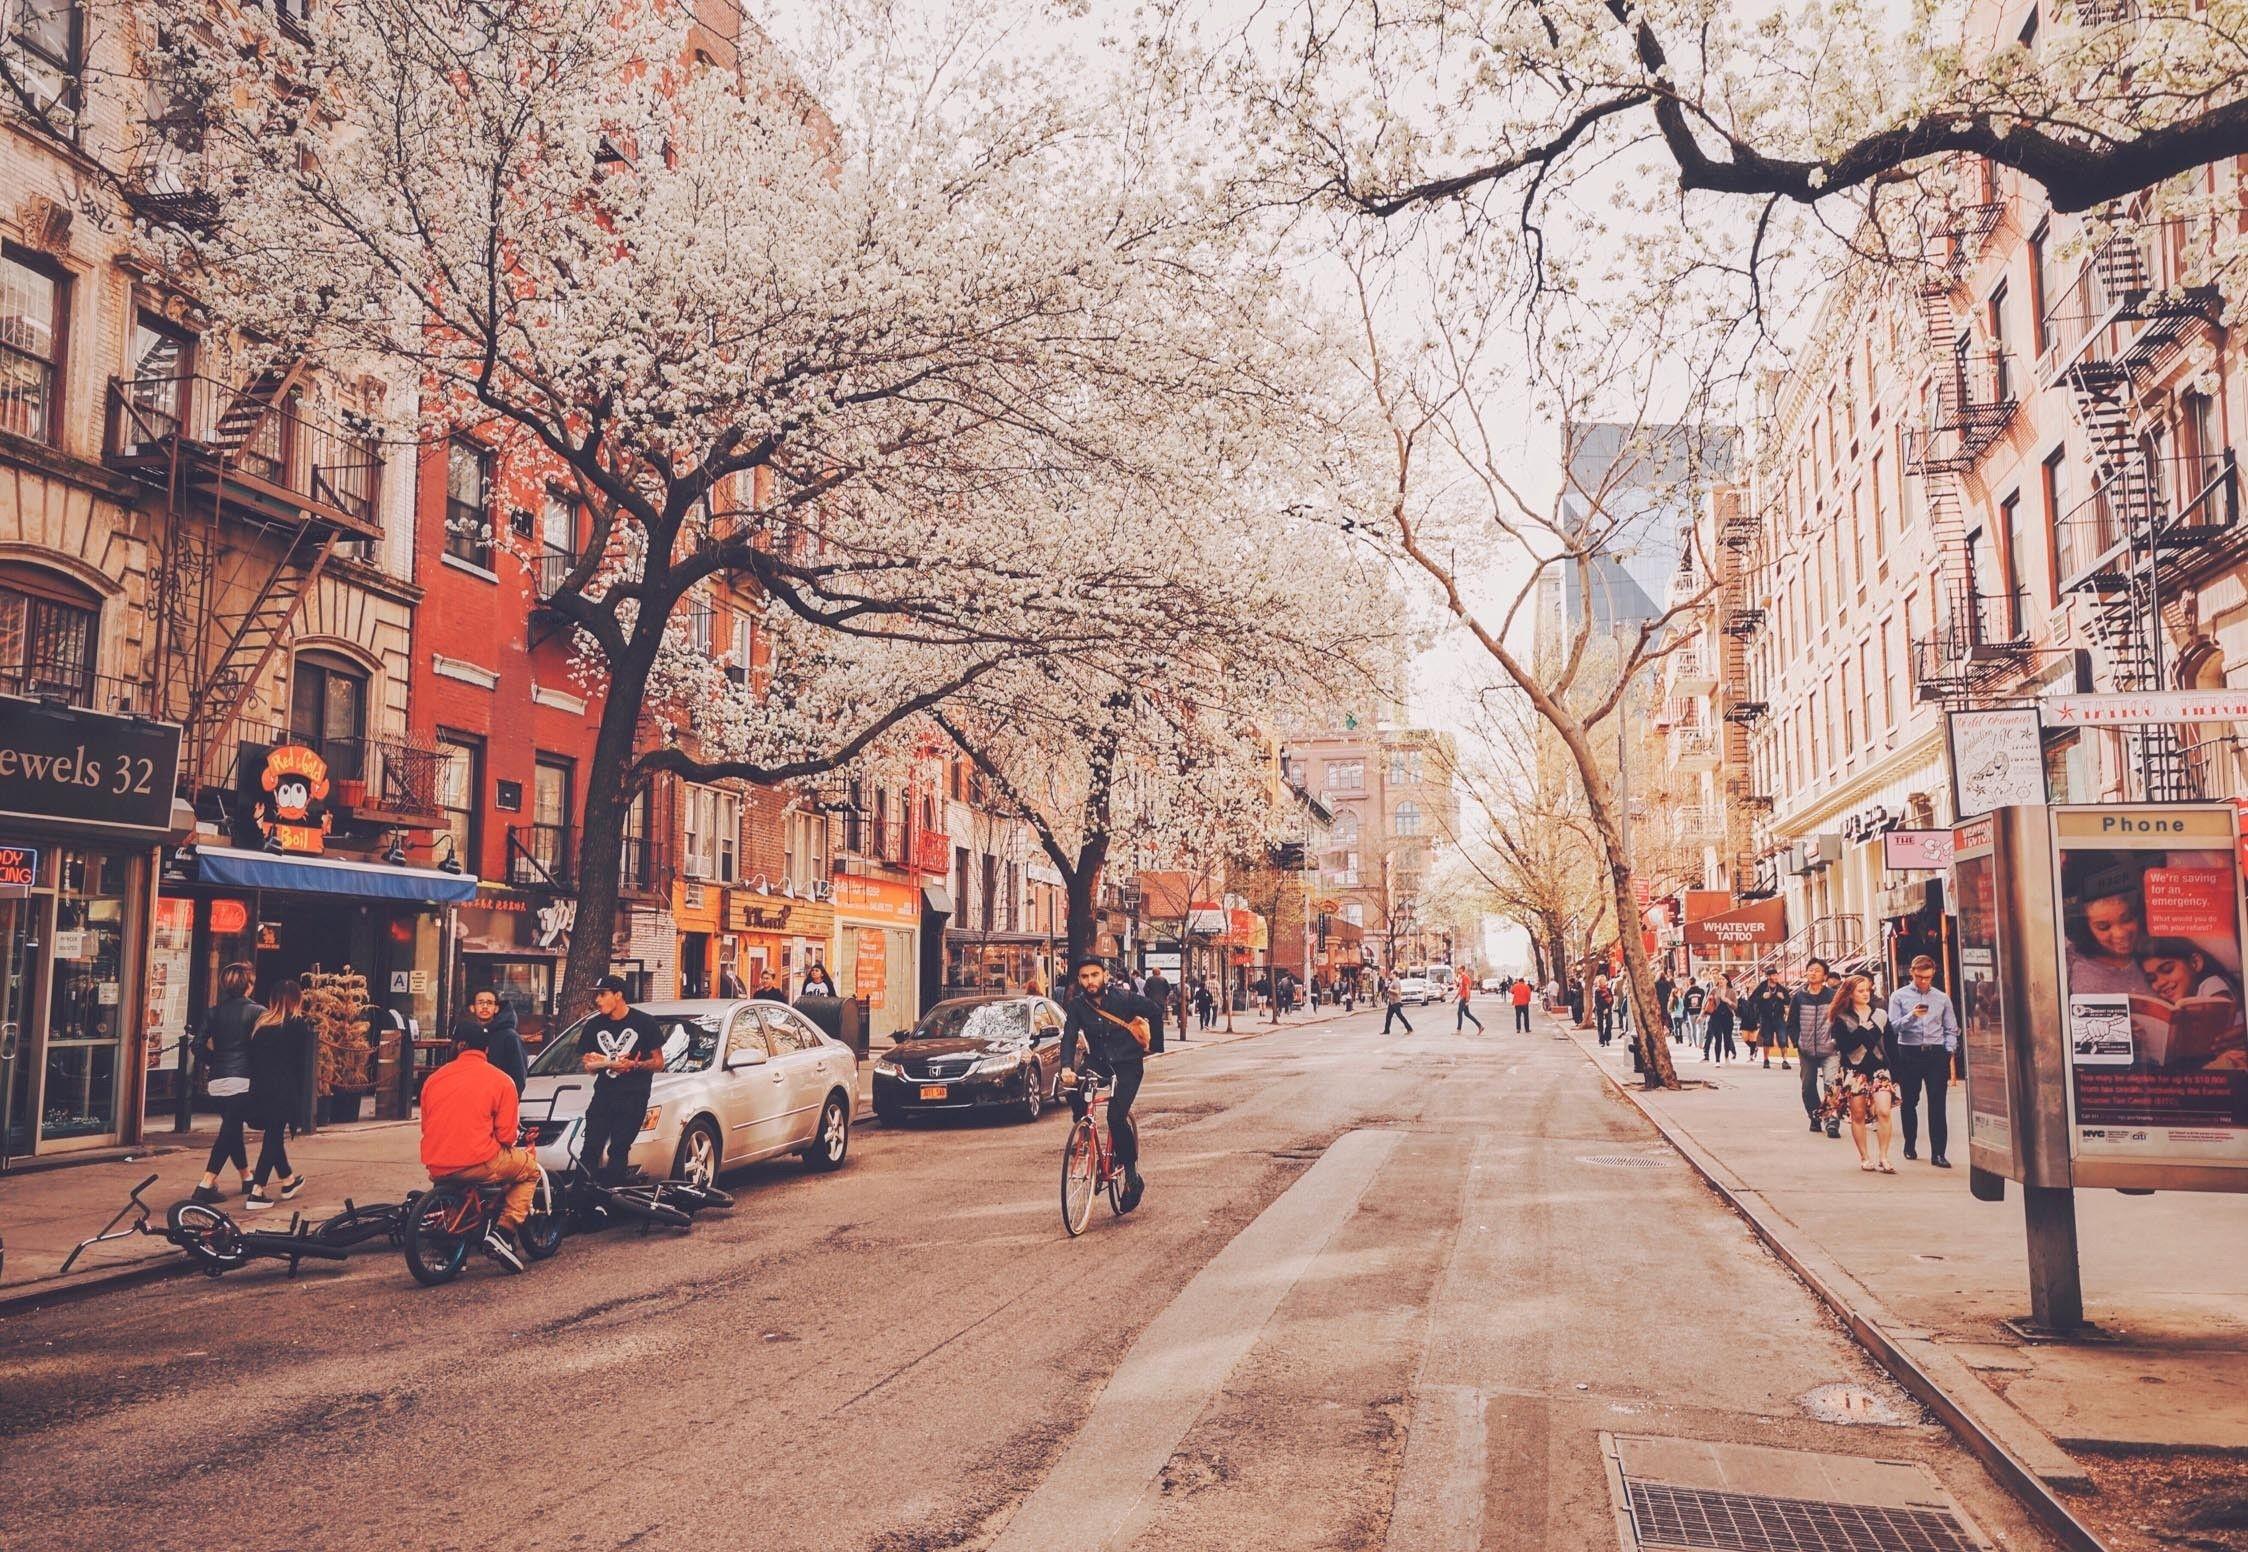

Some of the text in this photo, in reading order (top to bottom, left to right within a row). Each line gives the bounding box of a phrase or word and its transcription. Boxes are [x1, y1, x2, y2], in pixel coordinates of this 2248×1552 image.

[2080, 700, 2157, 719] TATTOO
[271, 747, 294, 772] Red
[302, 751, 324, 781] Gold
[112, 755, 153, 794] 32
[2103, 817, 2184, 832] Phone
[282, 826, 308, 849] Boil
[1896, 836, 1914, 845] THE
[0, 850, 23, 865] DY
[2150, 873, 2217, 885] We're saving
[2151, 885, 2181, 895] for an
[2151, 897, 2209, 908] emergency.
[2193, 916, 2207, 924] you
[1703, 922, 1766, 932] WHATEVER
[1716, 931, 1752, 941] TATTOO
[393, 975, 405, 987] A
[2082, 1129, 2106, 1138] NYC
[2132, 1133, 2147, 1141] citi
